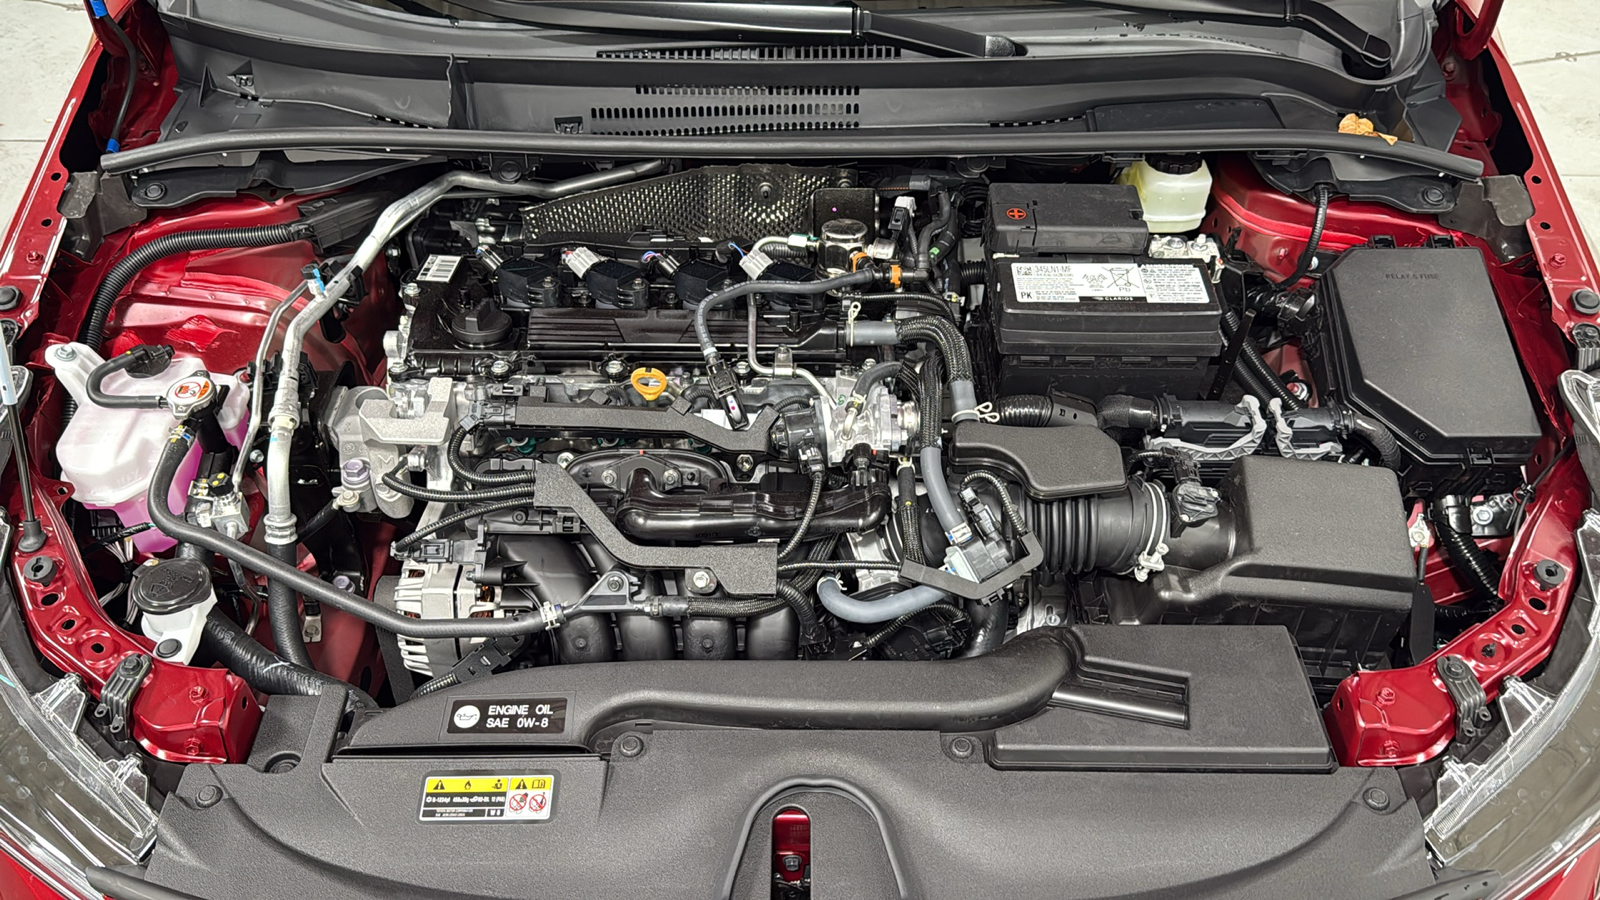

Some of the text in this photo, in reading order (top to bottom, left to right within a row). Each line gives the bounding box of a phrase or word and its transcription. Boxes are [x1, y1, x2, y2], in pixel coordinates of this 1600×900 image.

[1020, 291, 1033, 300] PK
[487, 704, 554, 715] ENGINE OIL
[485, 717, 549, 728] SAE 0W-8
